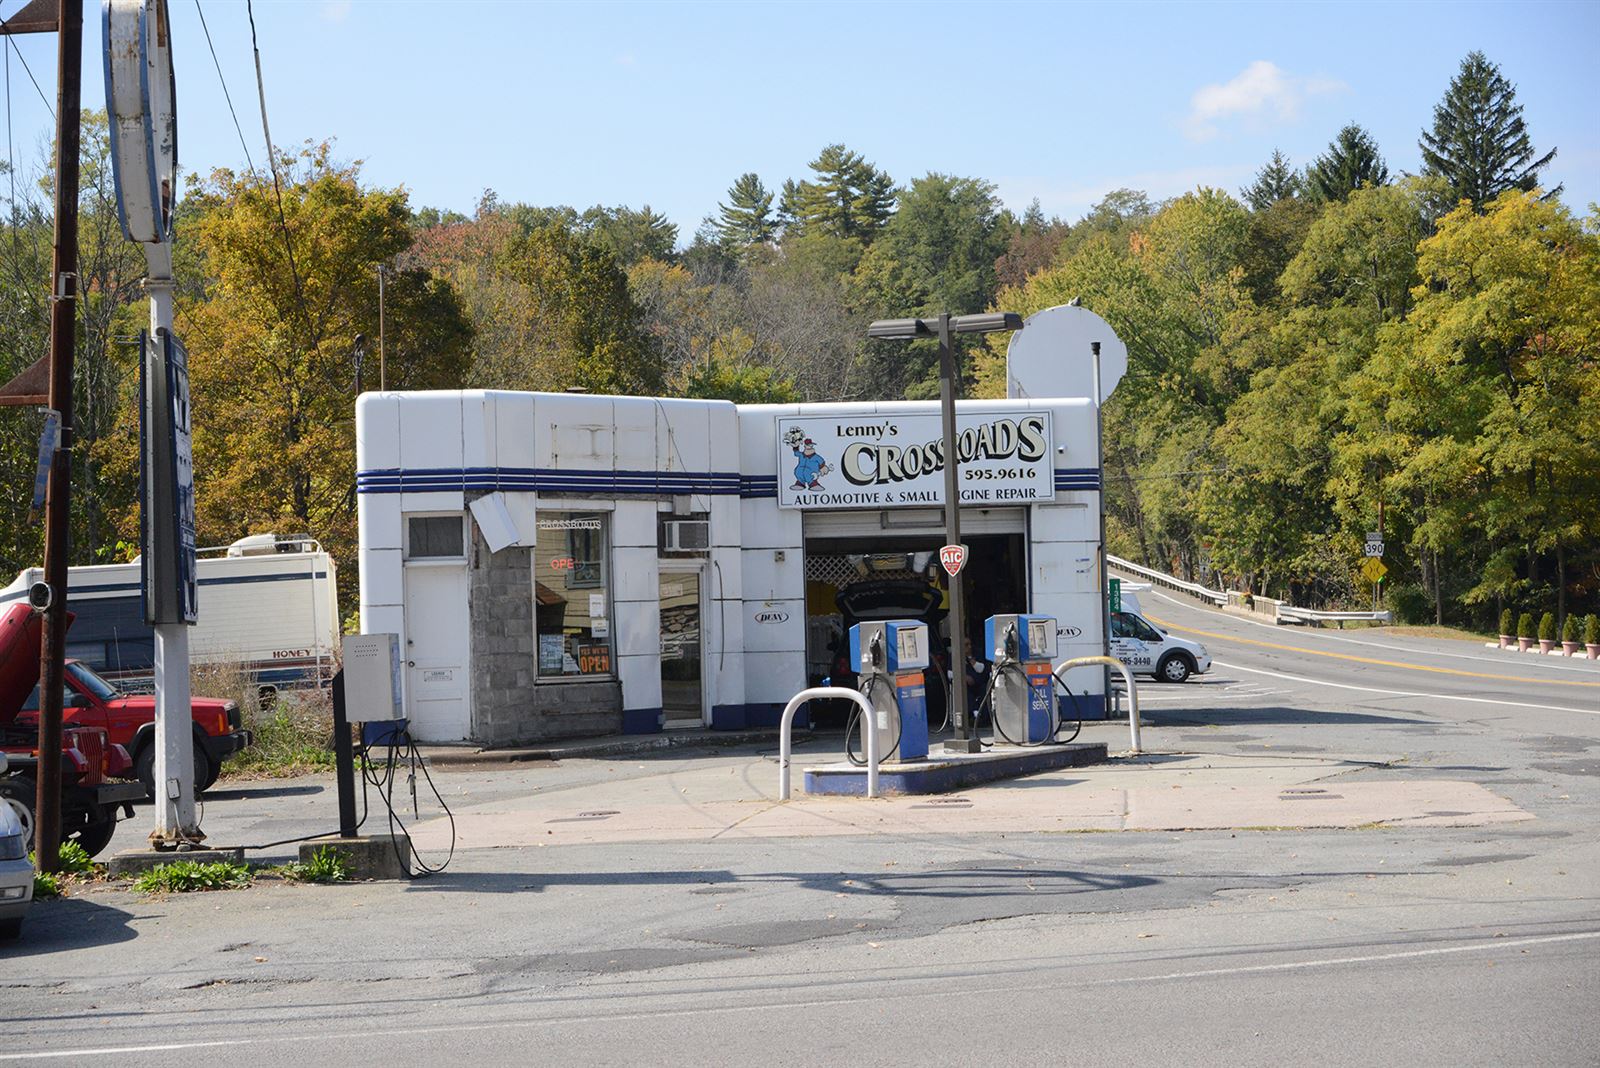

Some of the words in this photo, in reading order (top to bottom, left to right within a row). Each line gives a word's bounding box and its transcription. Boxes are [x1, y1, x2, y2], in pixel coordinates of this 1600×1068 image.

[837, 421, 898, 440] Lenny's
[965, 468, 1036, 480] 595.9616
[794, 493, 880, 505] AUTOMOTIVE
[885, 492, 894, 502] &
[899, 490, 940, 502] SMALL
[958, 489, 990, 500] GINE
[996, 487, 1037, 499] REPAIR
[1366, 544, 1383, 553] 390
[943, 552, 962, 563] AIC
[551, 558, 584, 570] OPE
[272, 649, 311, 659] HONEY
[580, 655, 609, 673] OPEN
[1032, 700, 1050, 710] SERE
